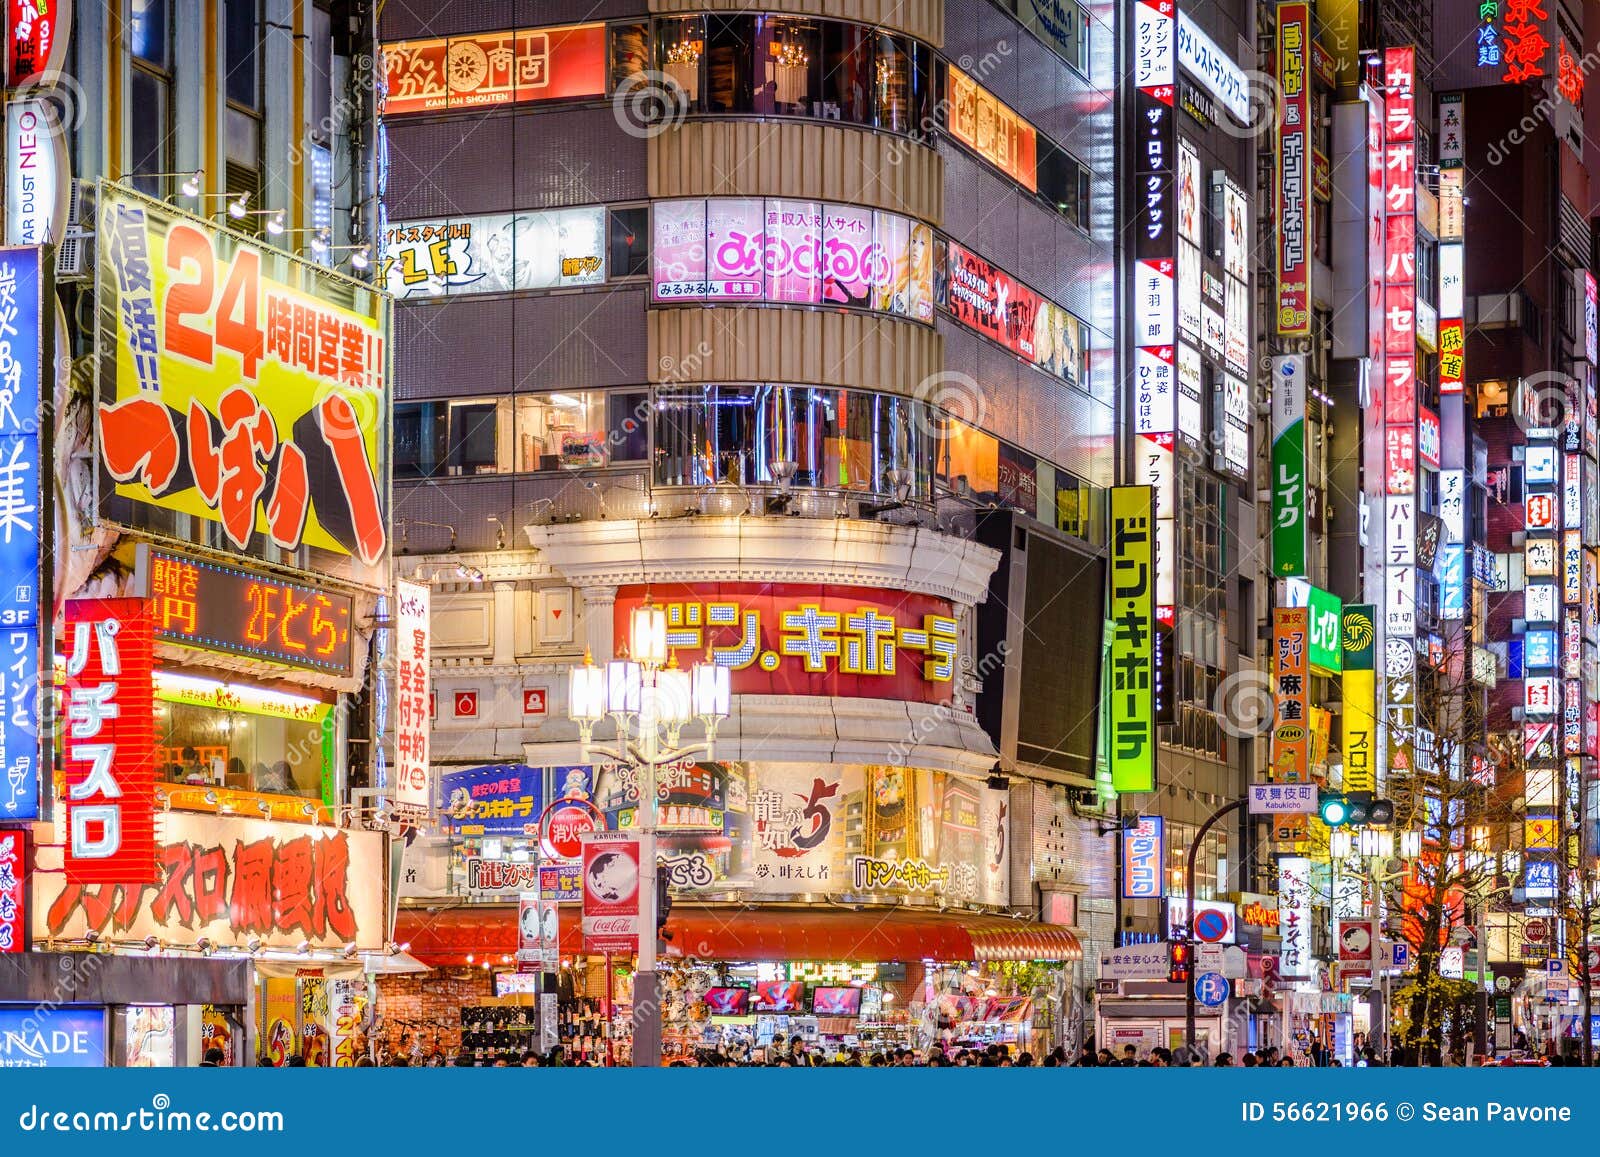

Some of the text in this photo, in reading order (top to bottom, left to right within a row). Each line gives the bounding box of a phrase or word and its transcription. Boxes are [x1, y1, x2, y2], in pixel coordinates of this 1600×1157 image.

[1159, 1, 1172, 12] 8F
[1282, 22, 1303, 97] まんが
[465, 92, 508, 104] SHOUTEN
[19, 111, 37, 169] NEO
[22, 174, 36, 215] DUST
[1282, 132, 1303, 272] インターネット
[767, 211, 867, 234] 高収入求人サイト
[1387, 68, 1414, 387] カラオケ パセラ
[1159, 262, 1172, 273] 5F
[660, 283, 719, 296] みるみるん
[1280, 307, 1306, 328] 8F
[1158, 348, 1172, 359] 4F
[1441, 326, 1463, 379] 麻雀
[1278, 464, 1300, 528] レイク
[1115, 517, 1149, 761] ドン・キホーテ
[1310, 604, 1338, 650] レイク
[1278, 674, 1302, 721] 麻雀
[66, 617, 123, 859] パチスロ
[1255, 787, 1312, 800] 歌舞伎町
[1265, 800, 1301, 809] Kabukicho
[1278, 827, 1302, 838] 3F
[1131, 837, 1155, 895] ダイコク
